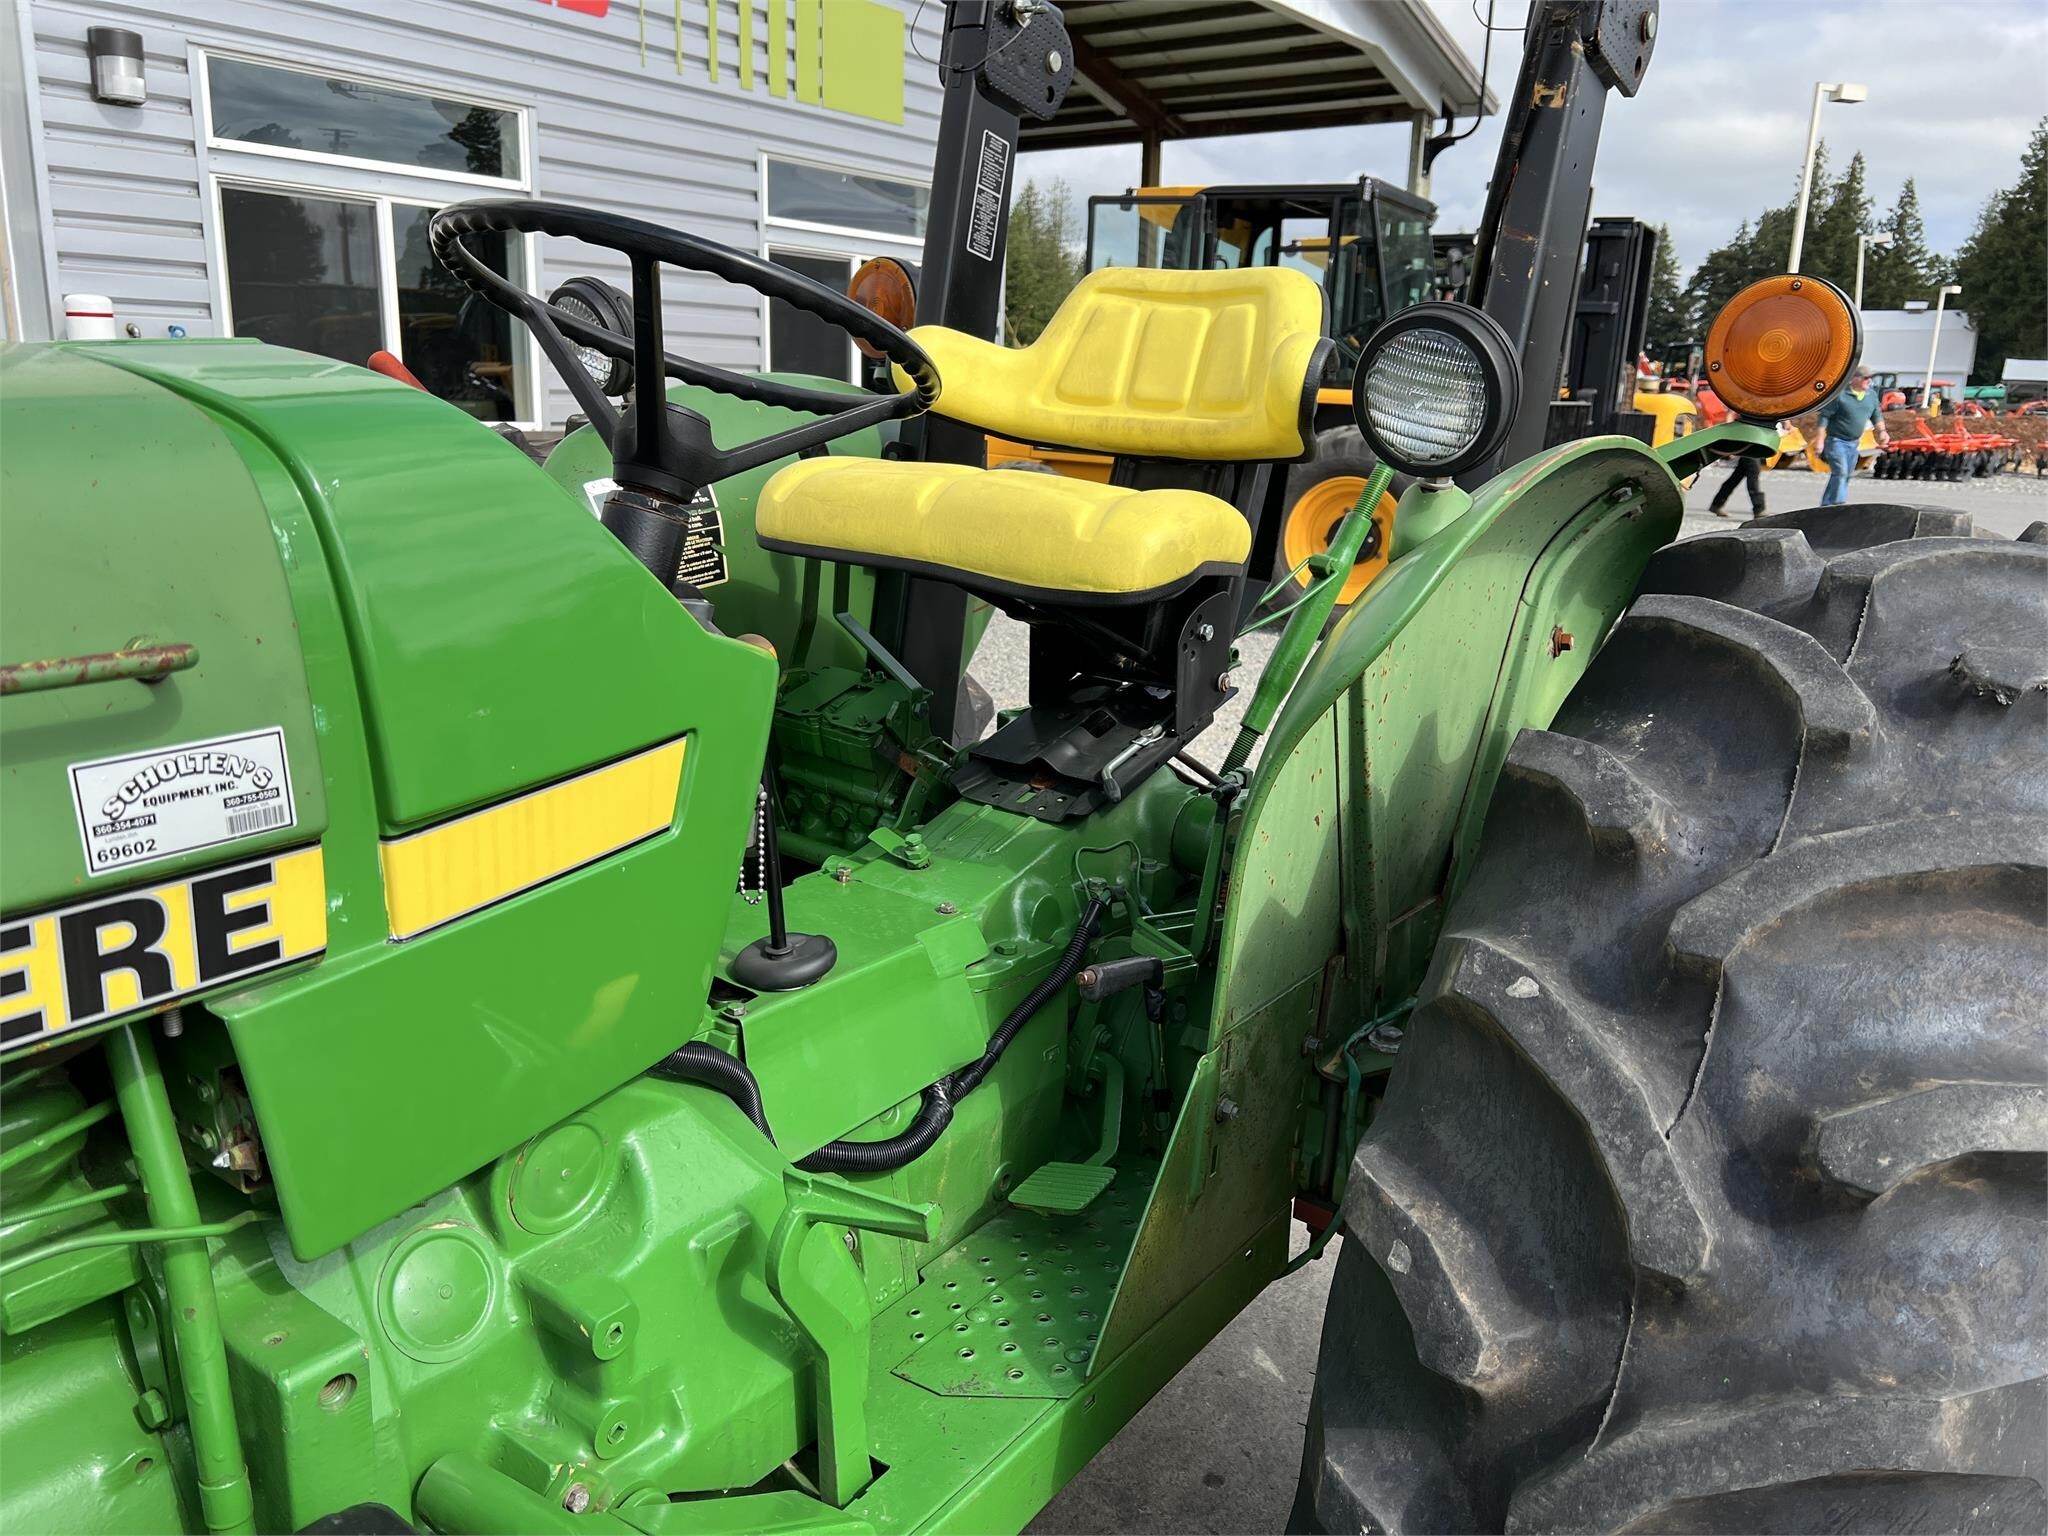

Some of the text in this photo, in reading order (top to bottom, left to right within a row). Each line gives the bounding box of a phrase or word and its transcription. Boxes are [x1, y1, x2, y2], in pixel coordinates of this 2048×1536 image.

[102, 752, 273, 820] SCHOLTEN'S
[215, 780, 239, 793] INC.
[225, 789, 278, 808] 360-755-0560
[95, 815, 155, 835] 360-354-4071
[97, 838, 157, 863] 69602
